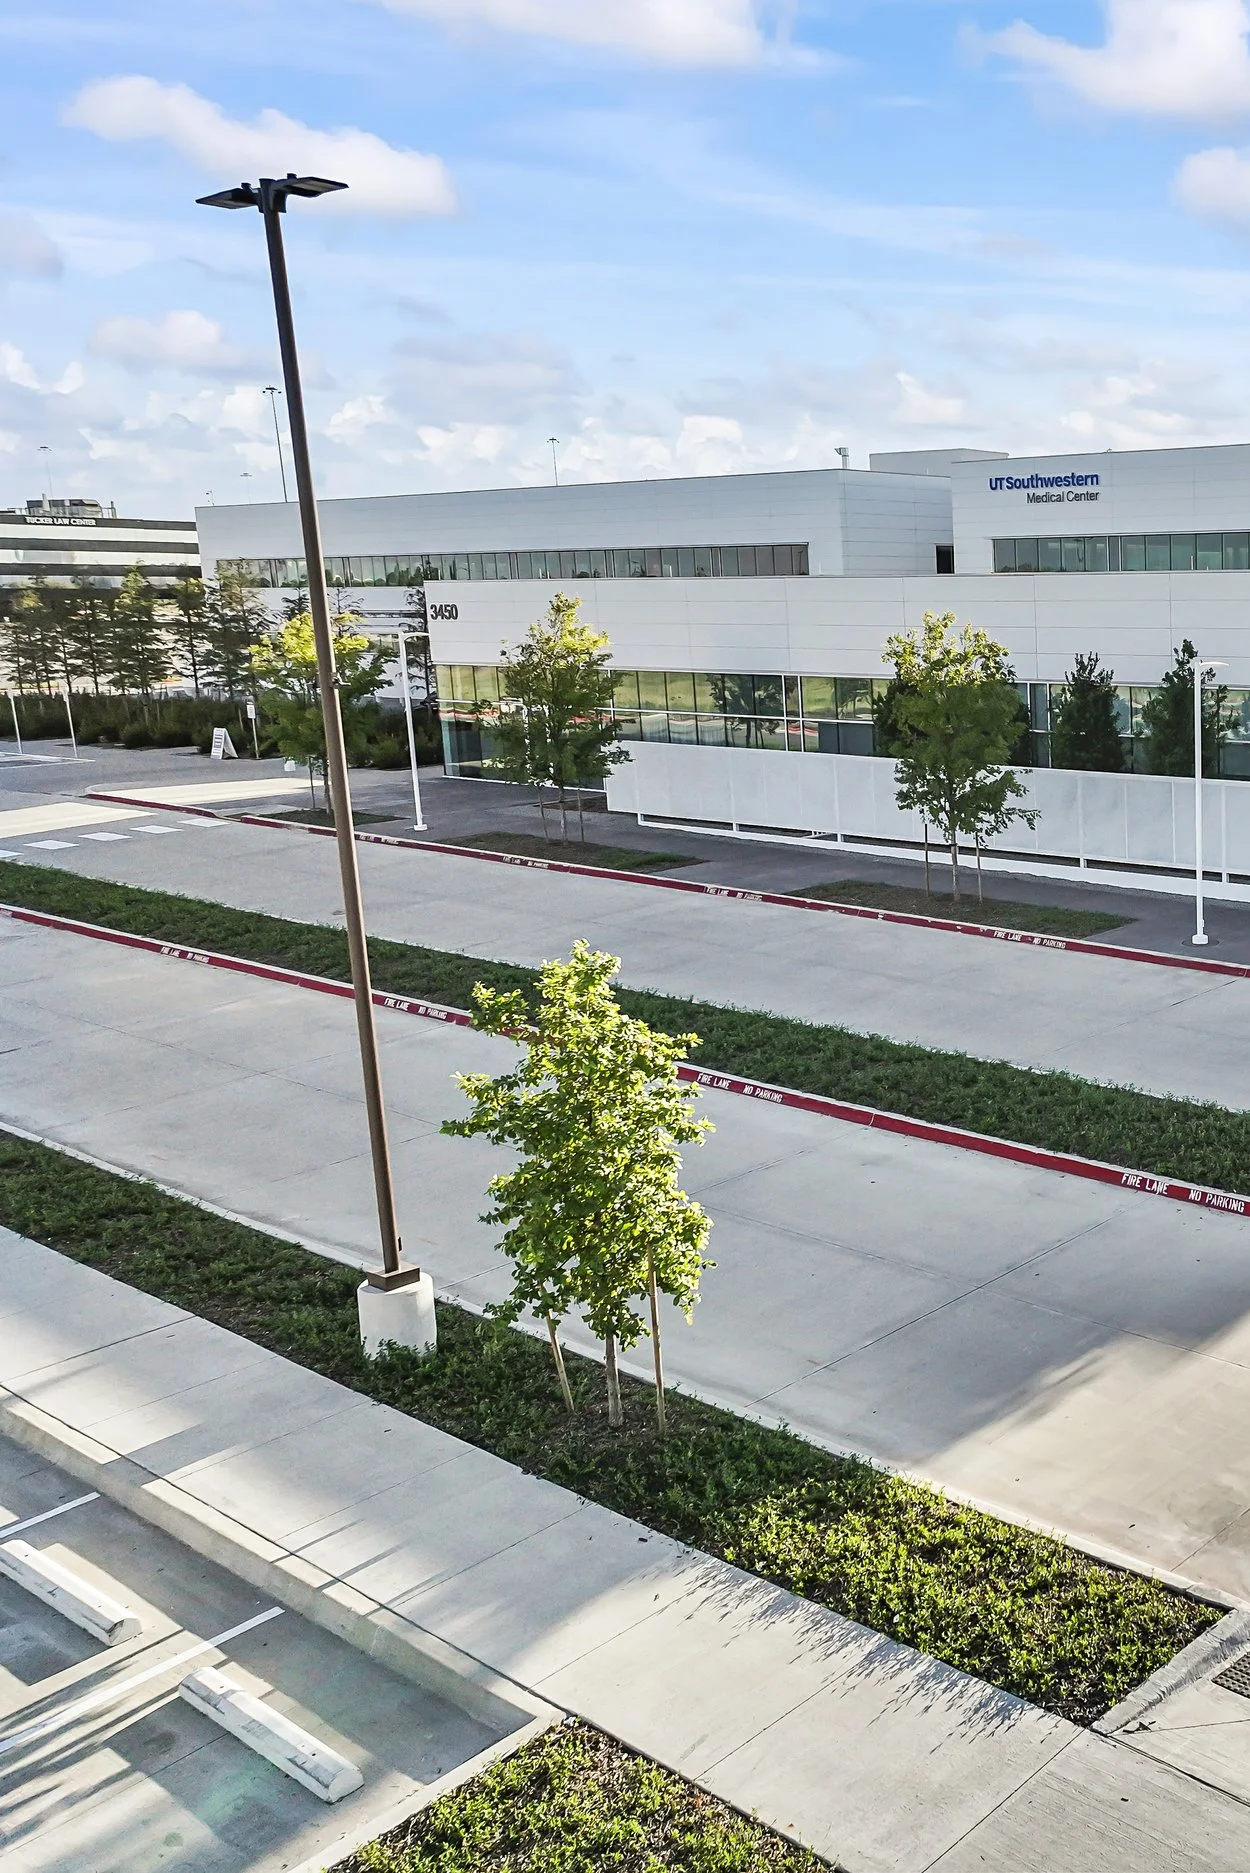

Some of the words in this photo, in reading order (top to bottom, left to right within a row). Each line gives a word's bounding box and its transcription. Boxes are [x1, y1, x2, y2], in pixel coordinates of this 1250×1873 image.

[1027, 491, 1064, 504] Medical
[1066, 490, 1099, 502] Center
[25, 516, 54, 524] TUCKER
[53, 517, 69, 525] LAW
[70, 518, 96, 526] CENTER
[430, 604, 459, 620] 3450
[993, 930, 1007, 939] FIRE
[1008, 932, 1023, 942] LANE
[1032, 937, 1041, 945] NO
[1042, 939, 1067, 949] PARKING
[697, 1072, 712, 1085] FIRE
[713, 1077, 732, 1091] LANE
[742, 1084, 753, 1096] NO
[754, 1088, 783, 1104] PARKING
[1121, 1173, 1143, 1188] FIRE
[1145, 1178, 1169, 1196] LANE
[1188, 1189, 1201, 1202] NO
[1205, 1193, 1245, 1214] PARKING
